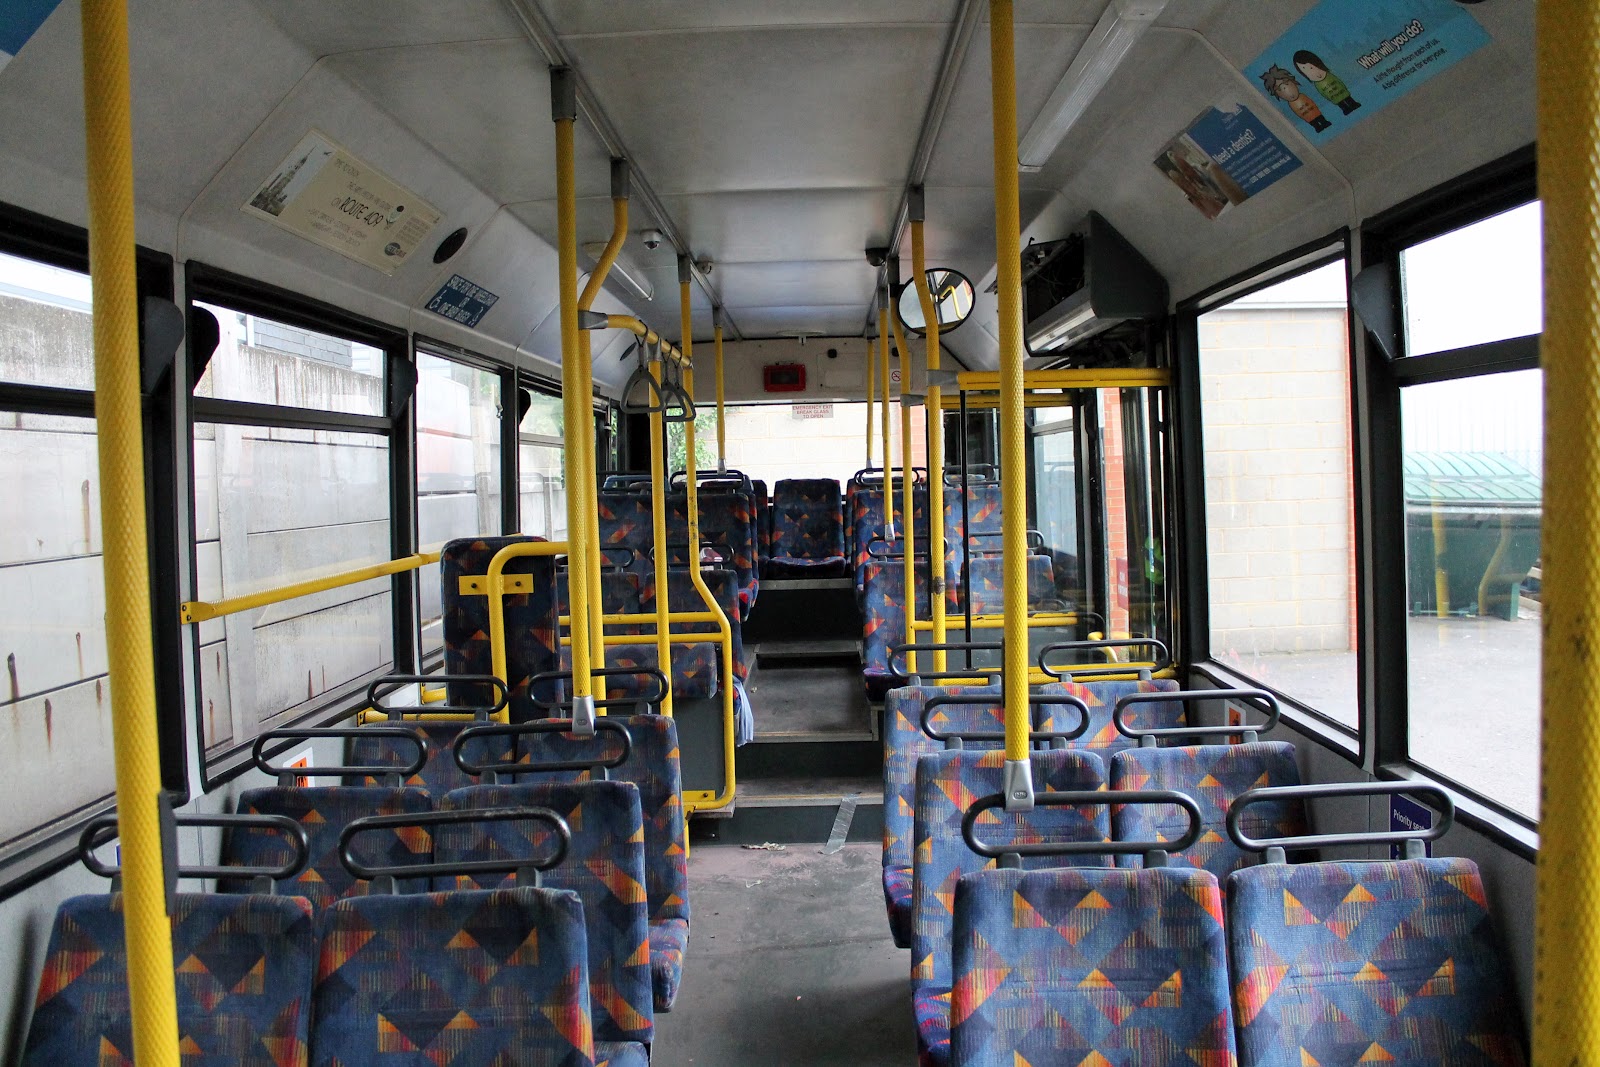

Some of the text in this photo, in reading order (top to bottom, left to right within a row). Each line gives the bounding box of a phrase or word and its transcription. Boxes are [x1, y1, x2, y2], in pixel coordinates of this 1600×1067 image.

[1357, 19, 1425, 70] What will you do?
[1386, 59, 1404, 76] thought
[1401, 54, 1416, 67] from
[1414, 45, 1427, 58] each
[1393, 66, 1418, 84] difference
[1423, 47, 1447, 66] everyone.
[1227, 147, 1236, 156] a
[1230, 128, 1257, 152] dentist?
[1212, 147, 1232, 165] Need
[339, 197, 369, 220] ROUTE
[363, 211, 384, 228] 409
[447, 276, 465, 291] SPACE
[1393, 808, 1413, 830] Priority
